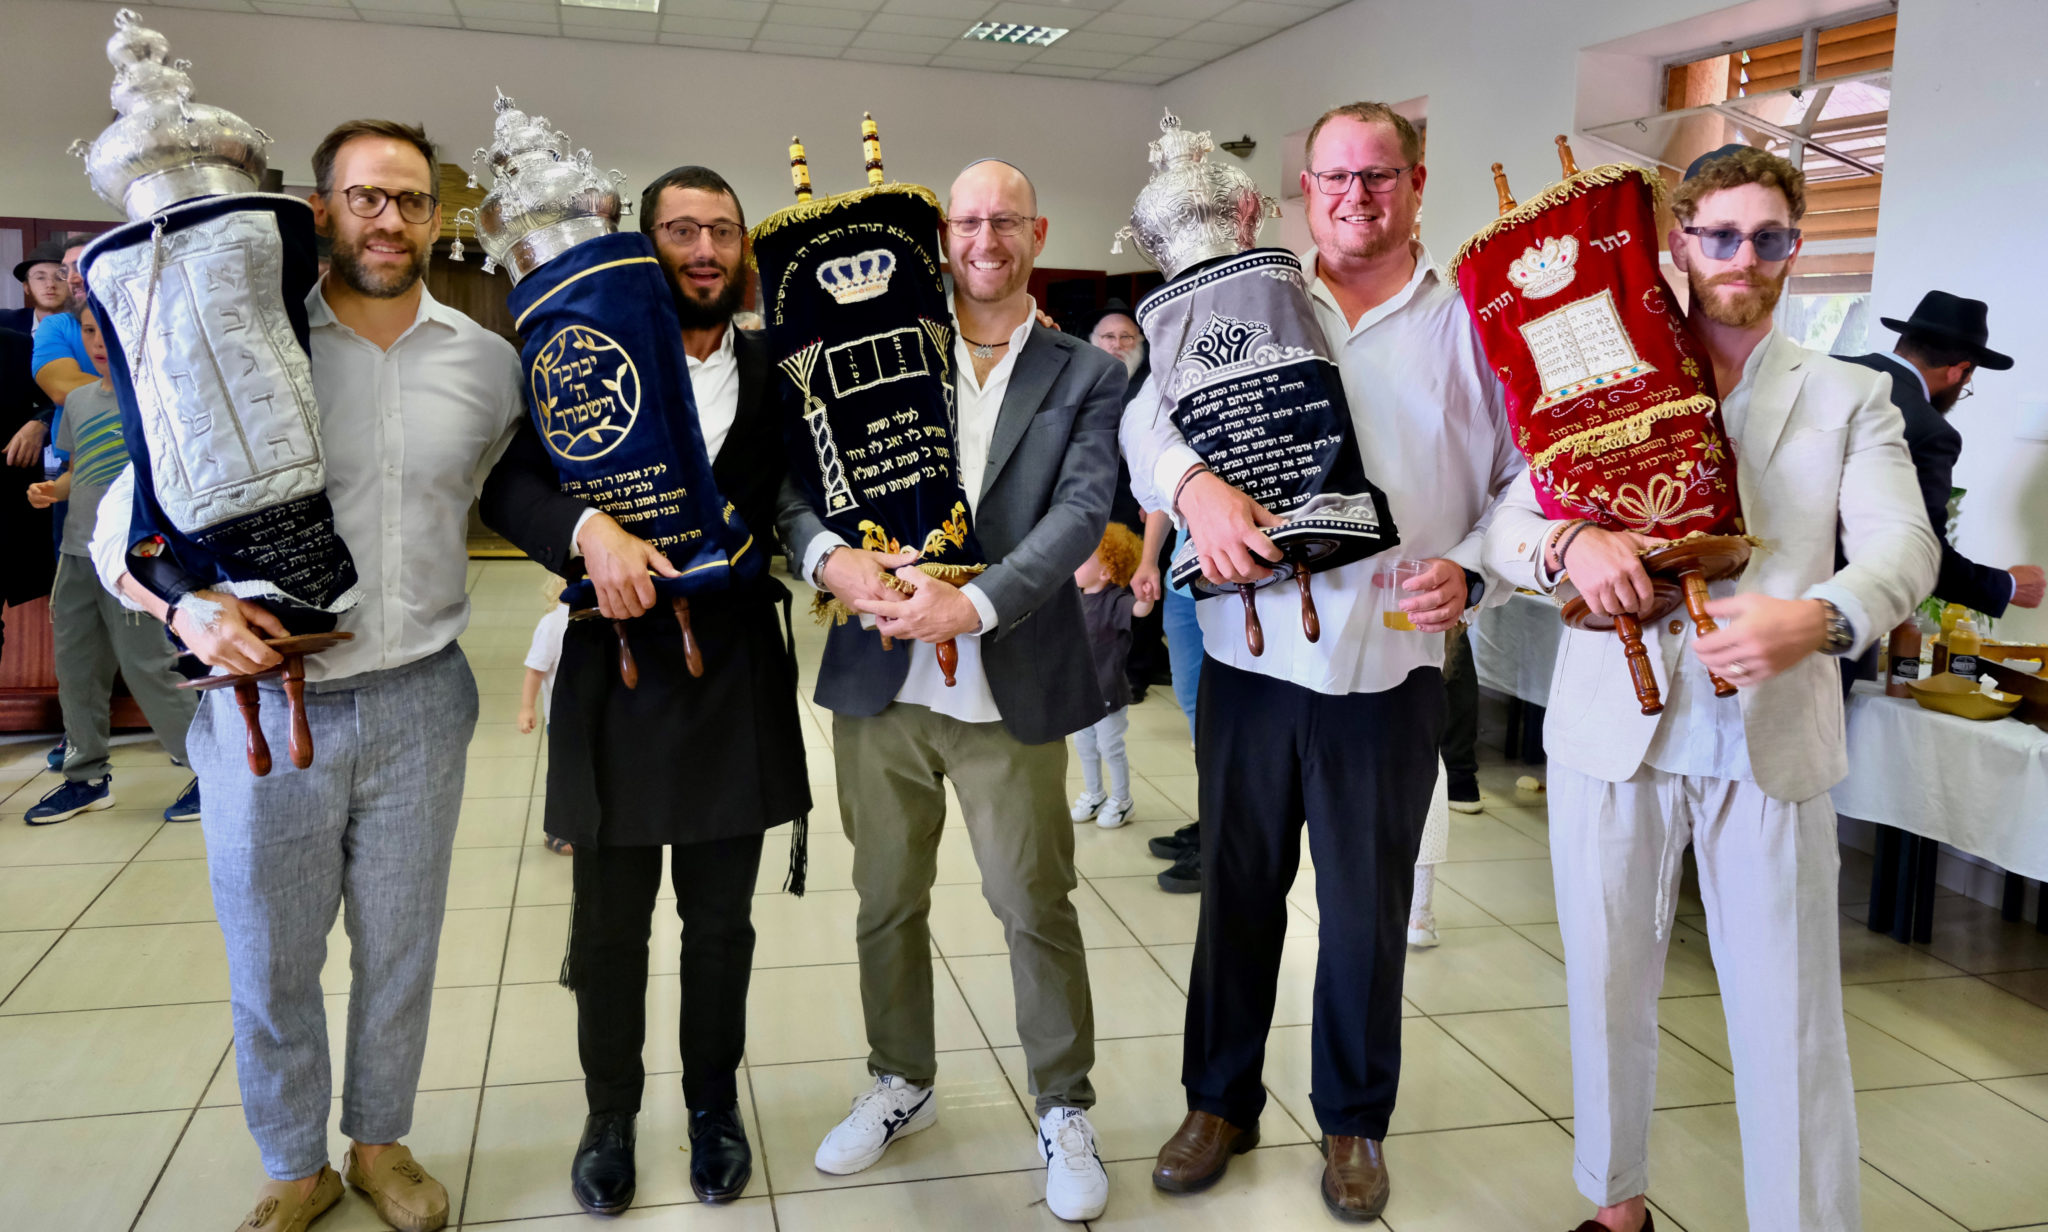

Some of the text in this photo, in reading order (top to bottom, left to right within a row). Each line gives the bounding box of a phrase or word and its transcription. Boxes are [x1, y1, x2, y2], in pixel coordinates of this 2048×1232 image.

[848, 223, 884, 234] תורה
[810, 228, 845, 246] ודבר
[887, 225, 914, 246] תצא
[1590, 230, 1632, 253] כתר
[1478, 290, 1514, 322] תורה
[1596, 314, 1610, 326] לא
[1602, 324, 1616, 336] לא
[552, 356, 598, 388] יברכך
[1242, 379, 1260, 390] תורה
[1263, 374, 1279, 384] ספר
[570, 383, 588, 401] ה'
[1209, 388, 1228, 399] נכתב
[1230, 384, 1239, 392] זה
[1643, 384, 1681, 402] לעילוי
[1227, 388, 1264, 406] אברהם
[555, 396, 616, 432] וישמרך
[1192, 401, 1224, 419] ישעיהו
[1254, 403, 1264, 413] בן
[1273, 408, 1293, 420] שלום
[1608, 401, 1640, 418] נשמת
[866, 406, 919, 435] לעילוי נשמת
[1225, 419, 1244, 430] ומרת
[1247, 414, 1270, 425] דובער
[1228, 426, 1266, 442] גראנער
[1328, 435, 1341, 444] של
[1670, 429, 1695, 444] מאת
[884, 435, 903, 450] זאב
[1208, 434, 1294, 462] זכה ושימש בתור שליח
[1629, 438, 1668, 457] משפחת
[846, 448, 866, 460] זרחי
[896, 451, 919, 467] מנחם
[1245, 453, 1264, 464] דורנו
[1266, 448, 1284, 460] נשיא
[1296, 454, 1314, 465] אהב
[644, 462, 667, 477] לע"נ
[880, 459, 894, 472] אב
[1252, 462, 1280, 475] הבריות
[1282, 459, 1294, 468] את
[1568, 461, 1594, 477] שיחיו
[1603, 447, 1687, 480] לאריכות ימים
[615, 470, 641, 483] אבינו
[922, 466, 936, 478] בני
[1280, 470, 1300, 481] בדמי
[1301, 465, 1322, 478] נקטף
[569, 481, 582, 490] צבי
[587, 479, 602, 490] דוד
[624, 481, 654, 496] נלב"ע
[886, 472, 920, 492] משפחתו
[593, 490, 613, 502] שבט
[659, 488, 687, 502] ולזכות
[863, 484, 886, 499] שיחיו
[1293, 492, 1311, 504] נדבת
[634, 495, 658, 508] אמנו
[1279, 498, 1291, 506] בני
[660, 504, 680, 516] ובני
[660, 535, 678, 550] ניתן
